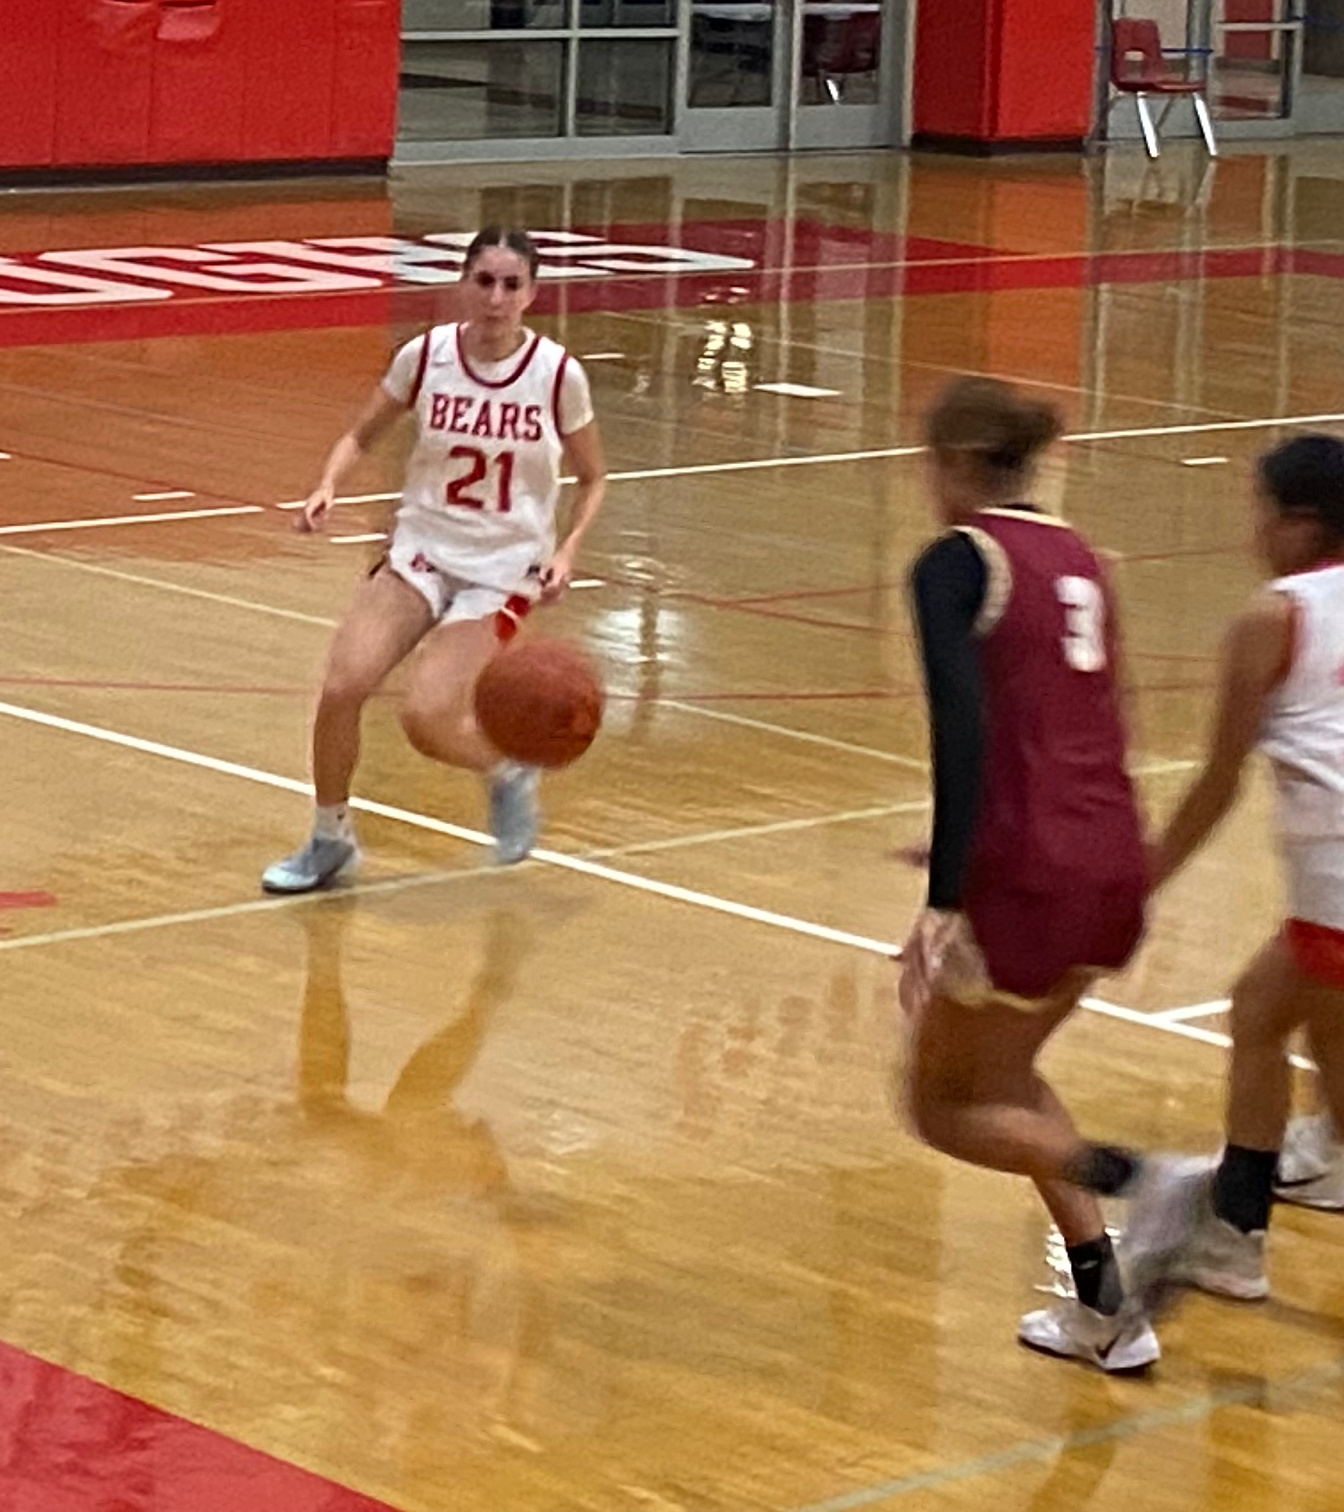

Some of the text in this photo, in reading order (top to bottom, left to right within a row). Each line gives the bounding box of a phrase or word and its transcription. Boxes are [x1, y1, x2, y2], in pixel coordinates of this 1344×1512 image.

[430, 393, 542, 441] BEARS
[446, 445, 515, 513] 21
[1057, 575, 1107, 673] 3
